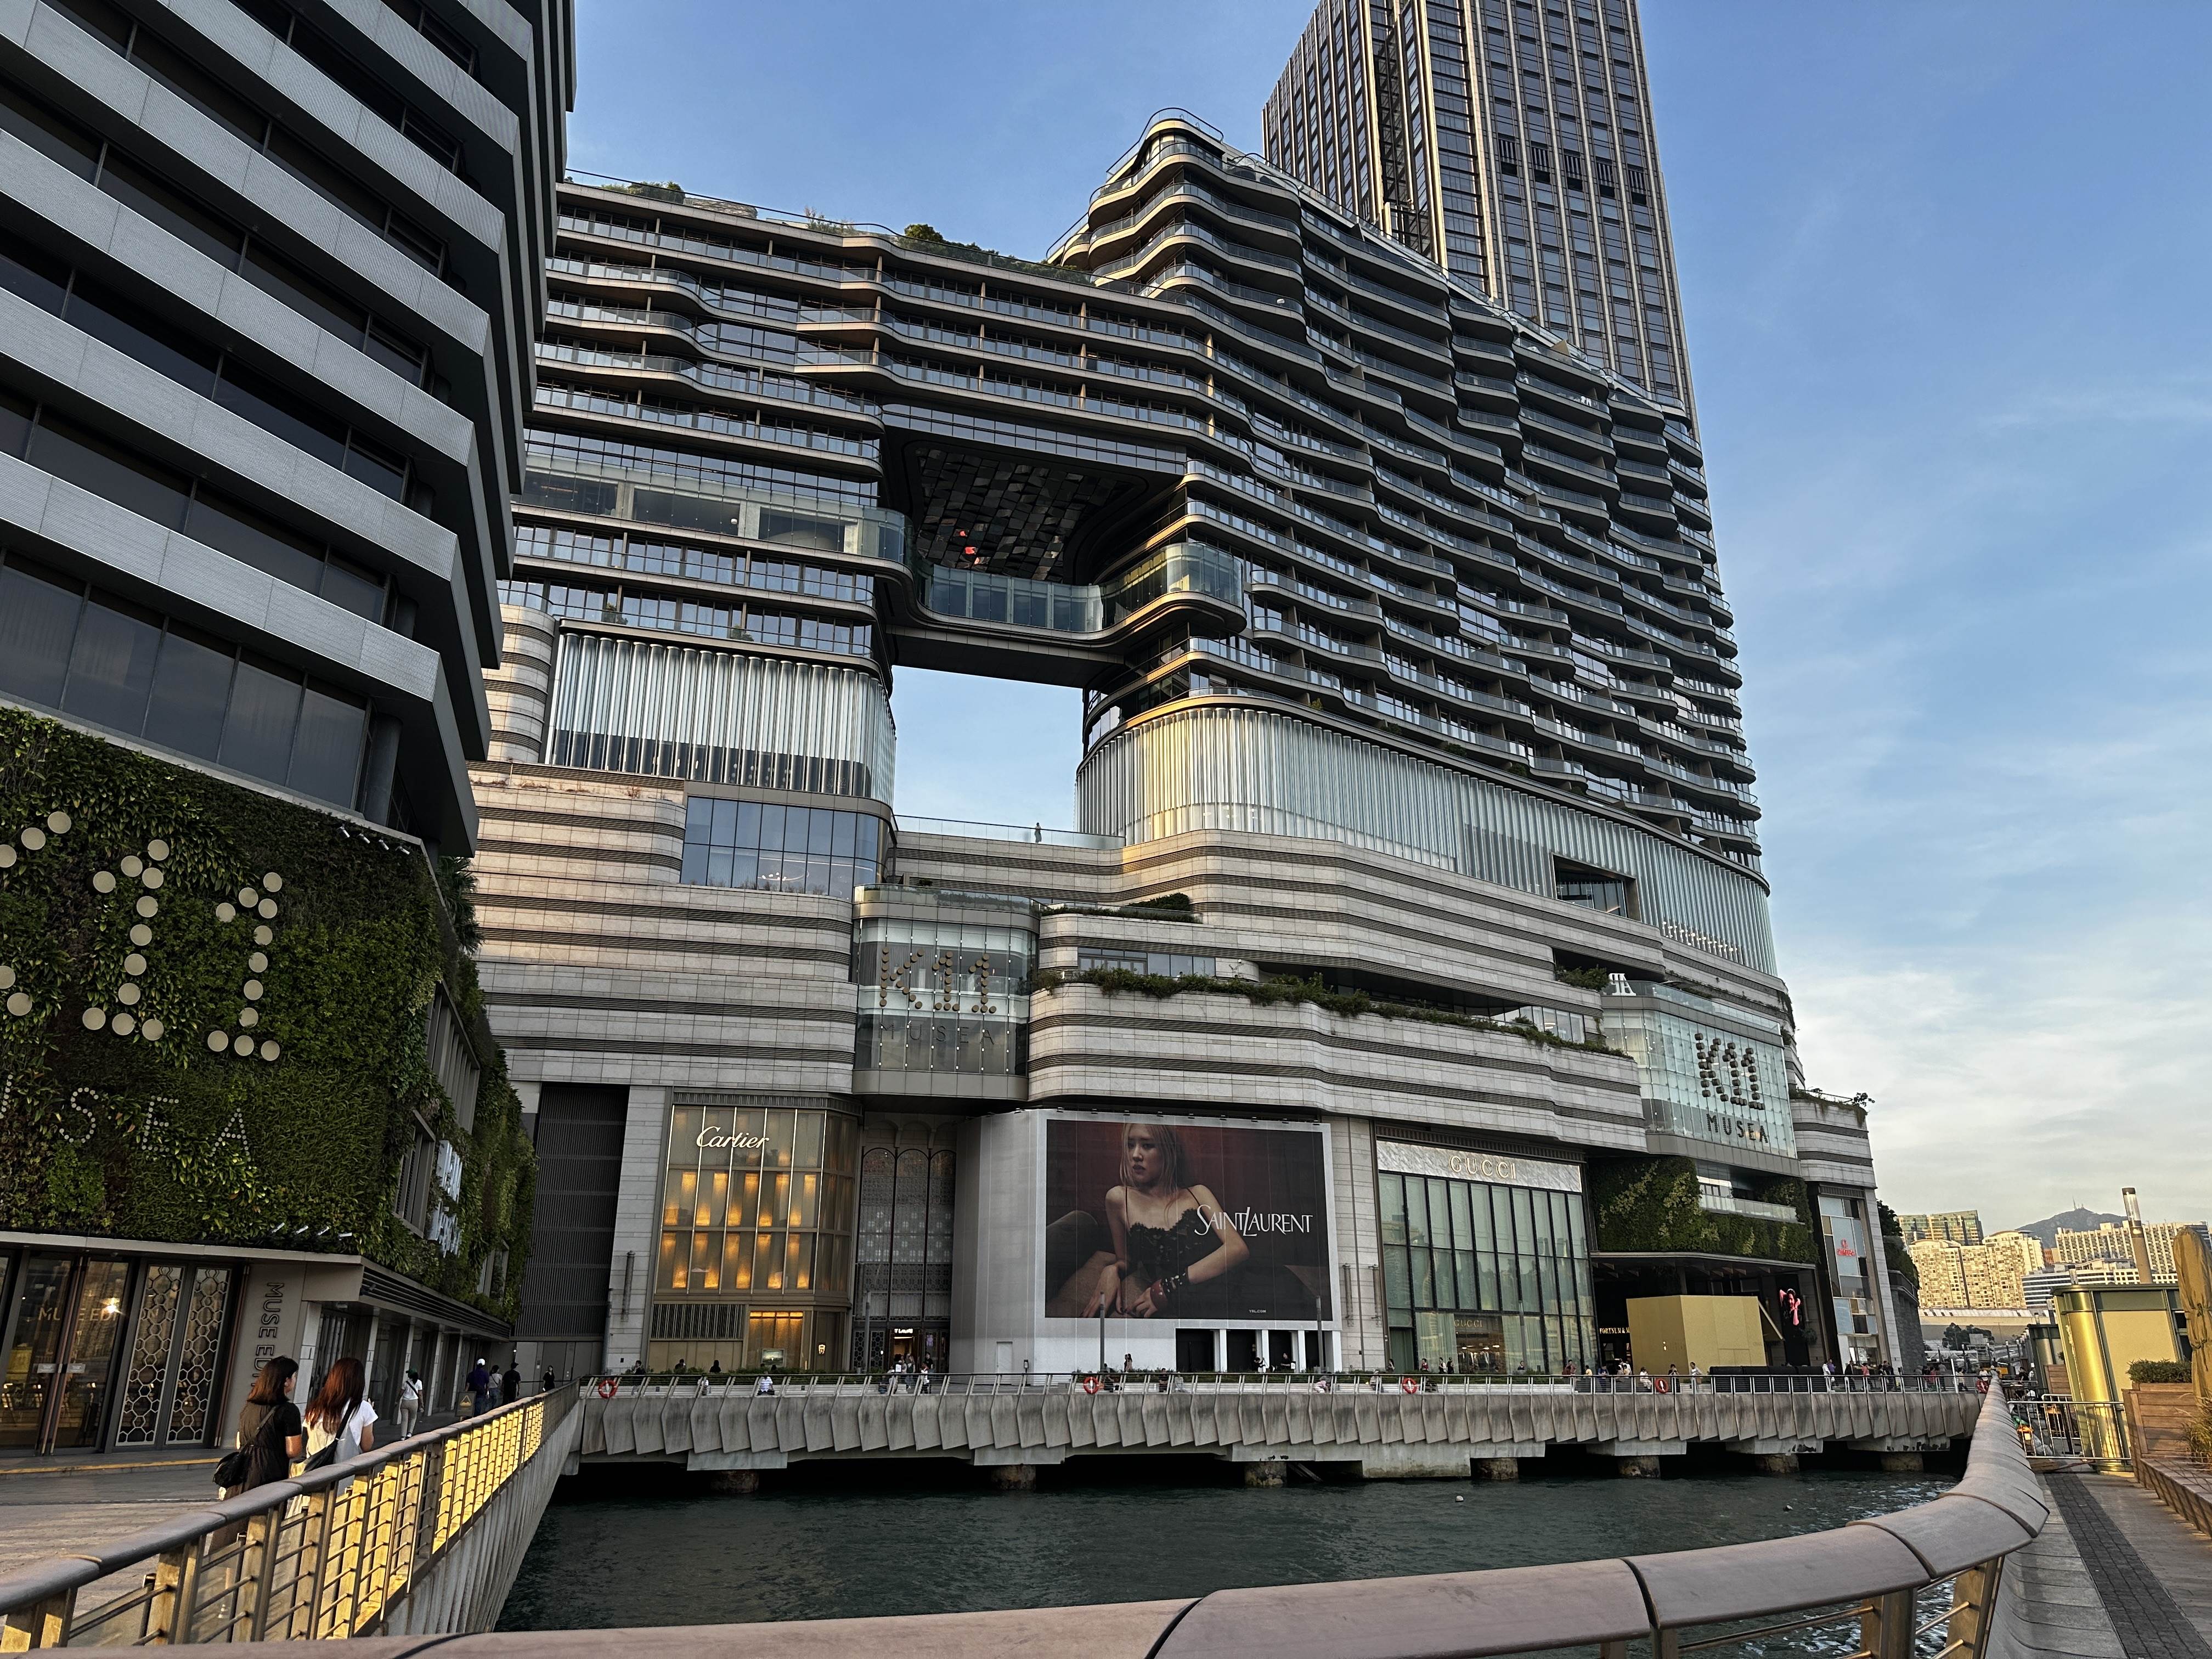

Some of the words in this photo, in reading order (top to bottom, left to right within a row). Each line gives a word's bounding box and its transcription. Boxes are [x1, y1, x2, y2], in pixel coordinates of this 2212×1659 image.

[879, 947, 996, 1013] K11
[878, 1023, 995, 1045] MUSEA
[1695, 1032, 1765, 1110] K11
[696, 1126, 770, 1148] Cartier
[1706, 1113, 1768, 1143] MUSEA
[1449, 1155, 1516, 1180] GUCCI
[258, 1282, 285, 1339] MUSE
[1454, 1319, 1482, 1328] GUCCI
